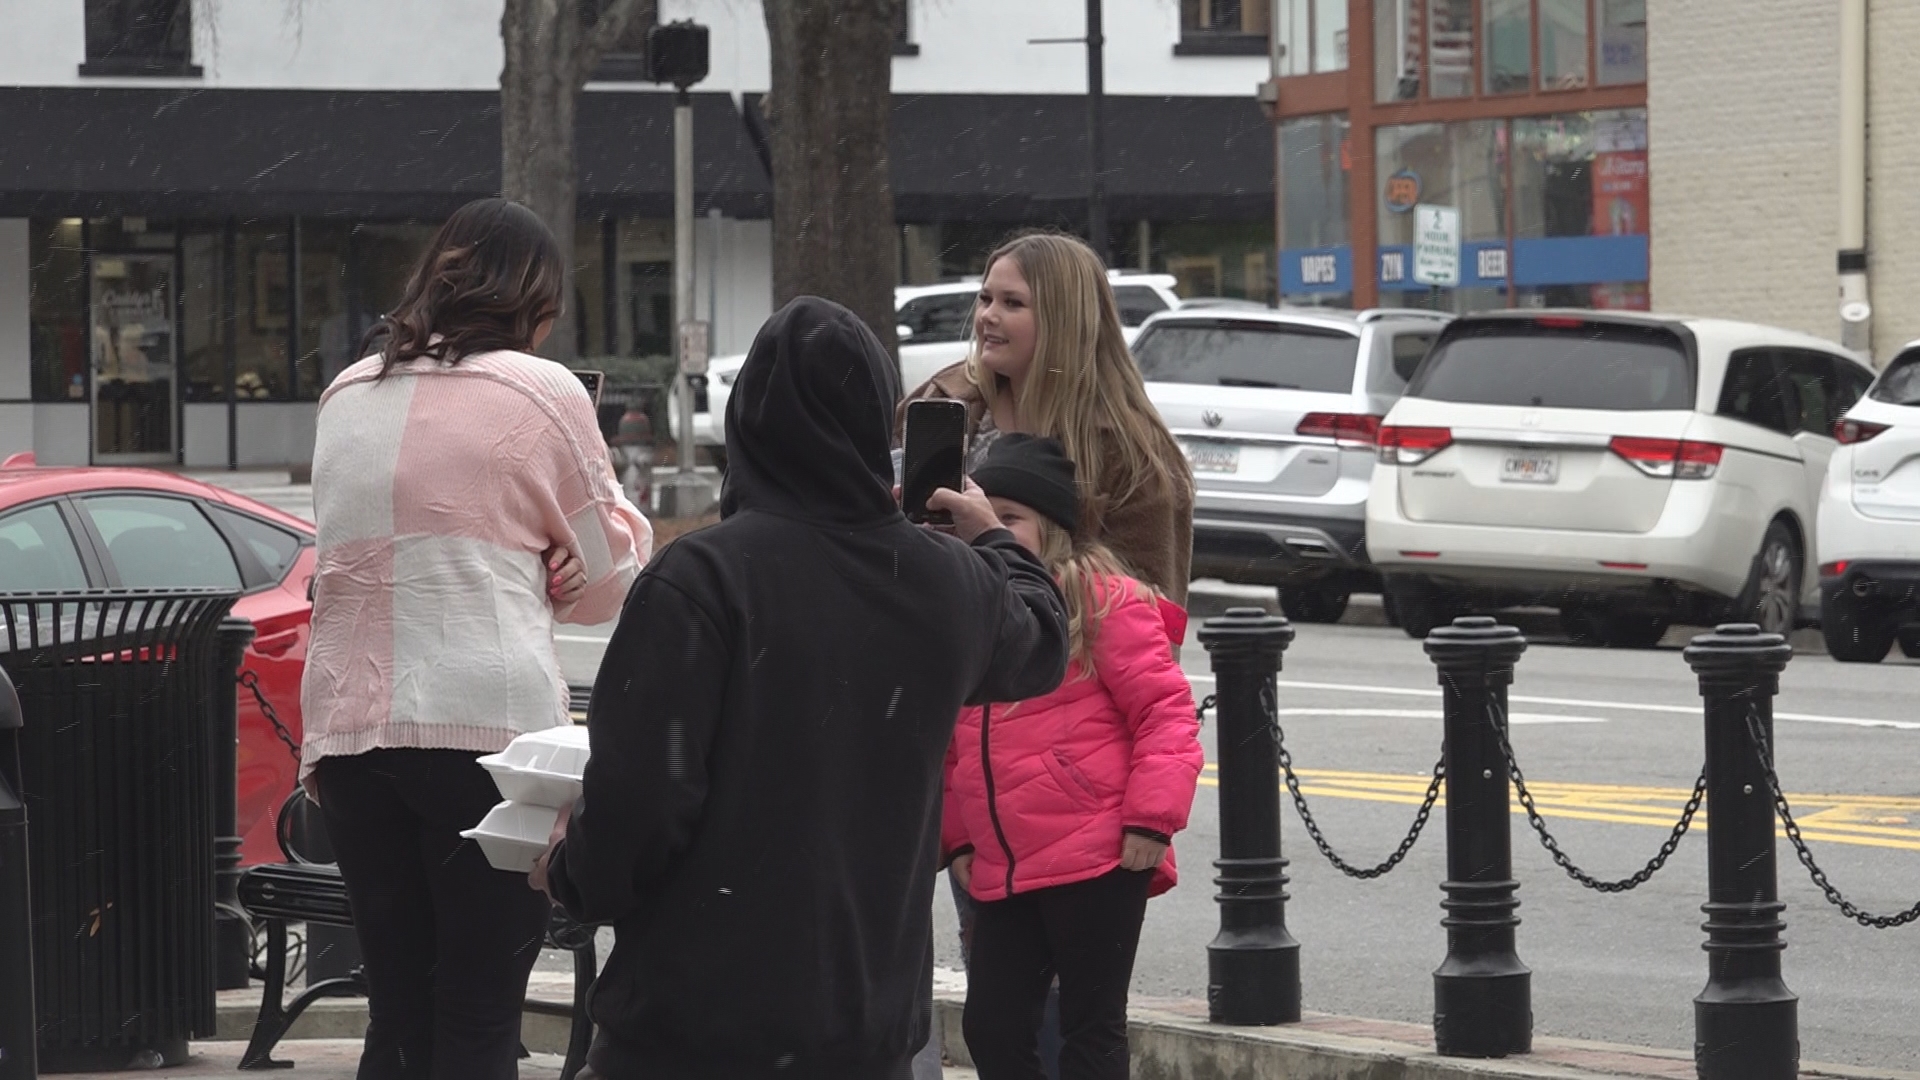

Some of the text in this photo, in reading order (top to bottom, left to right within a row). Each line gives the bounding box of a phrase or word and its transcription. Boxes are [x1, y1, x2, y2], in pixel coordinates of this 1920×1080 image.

[1433, 209, 1442, 229] 2
[1424, 231, 1449, 242] HOUR
[1416, 244, 1458, 257] PARKING
[1301, 249, 1507, 283] VAPES ZYN BEER
